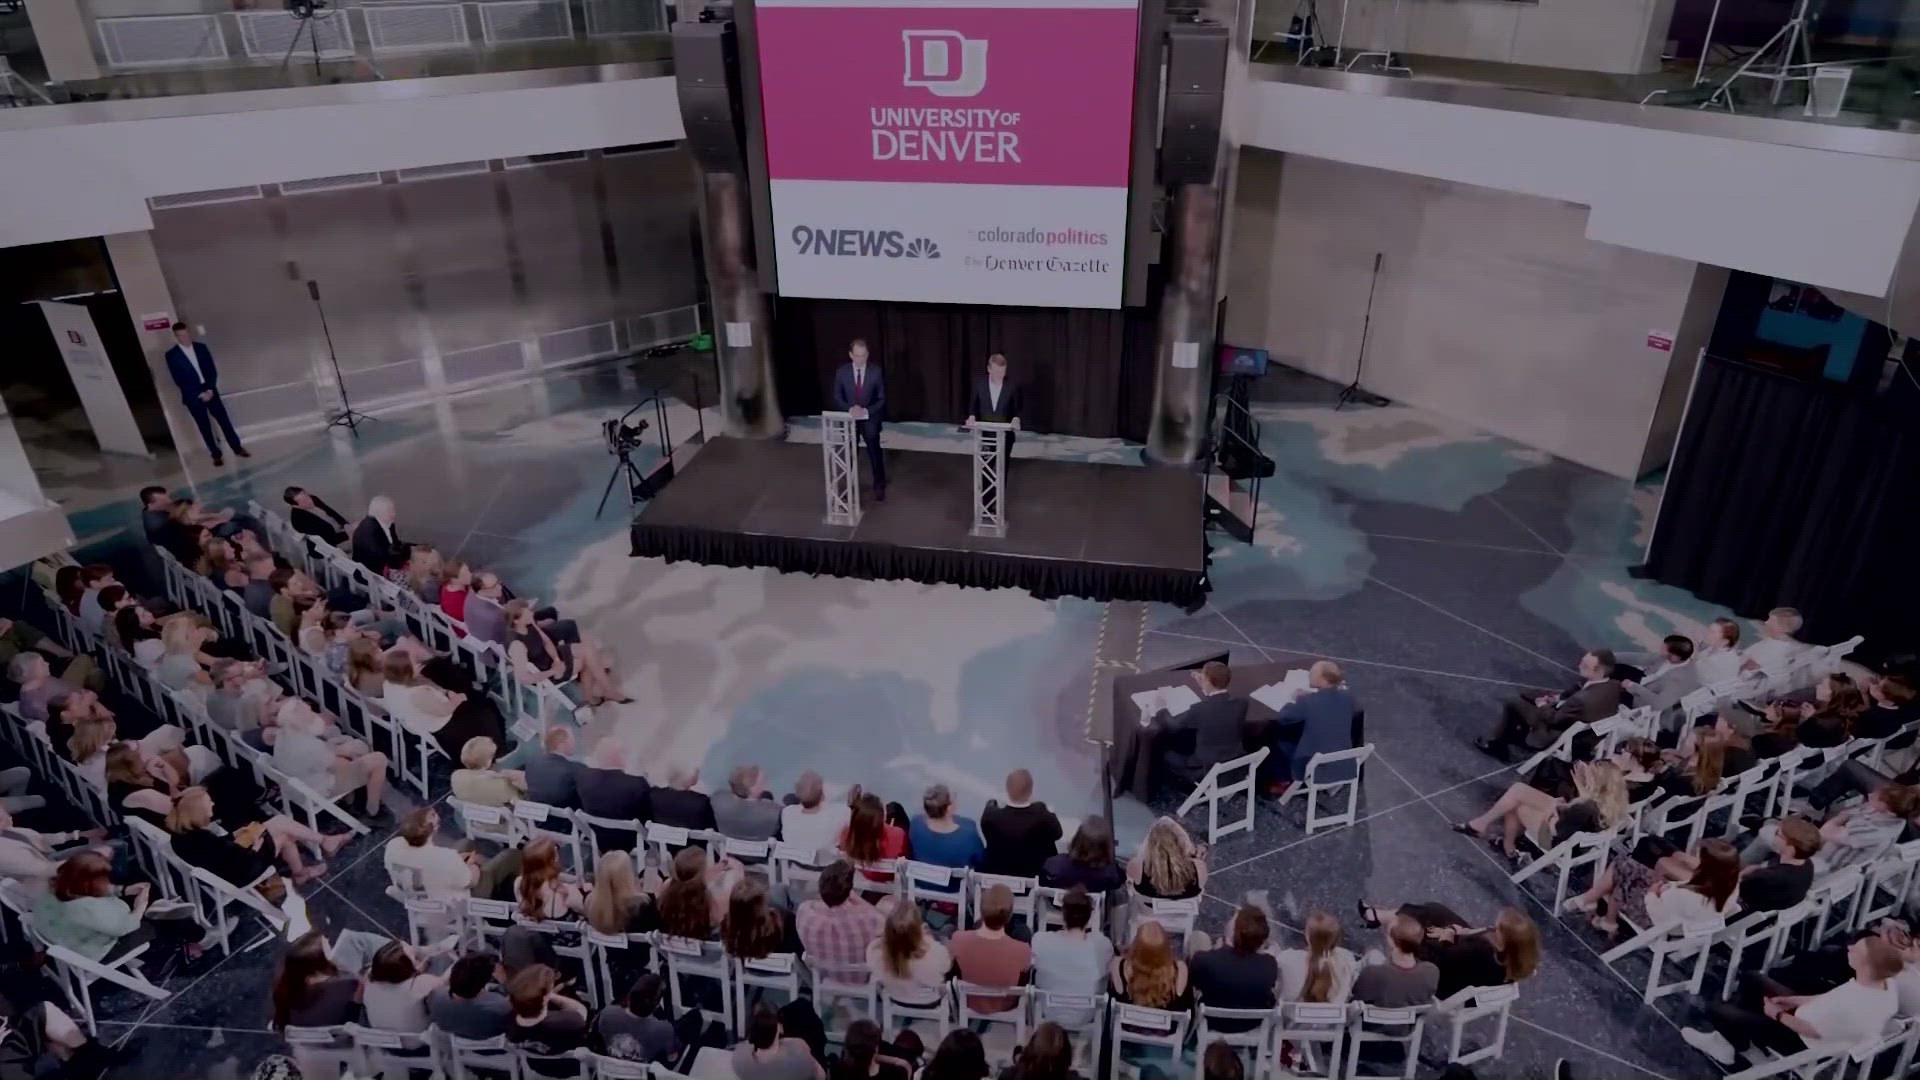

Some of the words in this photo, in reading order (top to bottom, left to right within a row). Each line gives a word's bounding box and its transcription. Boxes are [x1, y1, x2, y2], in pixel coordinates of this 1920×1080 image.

[870, 107, 1000, 128] UNIVERSITY
[1000, 112, 1021, 126] OF
[871, 129, 1022, 164] DENVER
[791, 224, 905, 259] 9NEWS
[985, 255, 1044, 271] Denver
